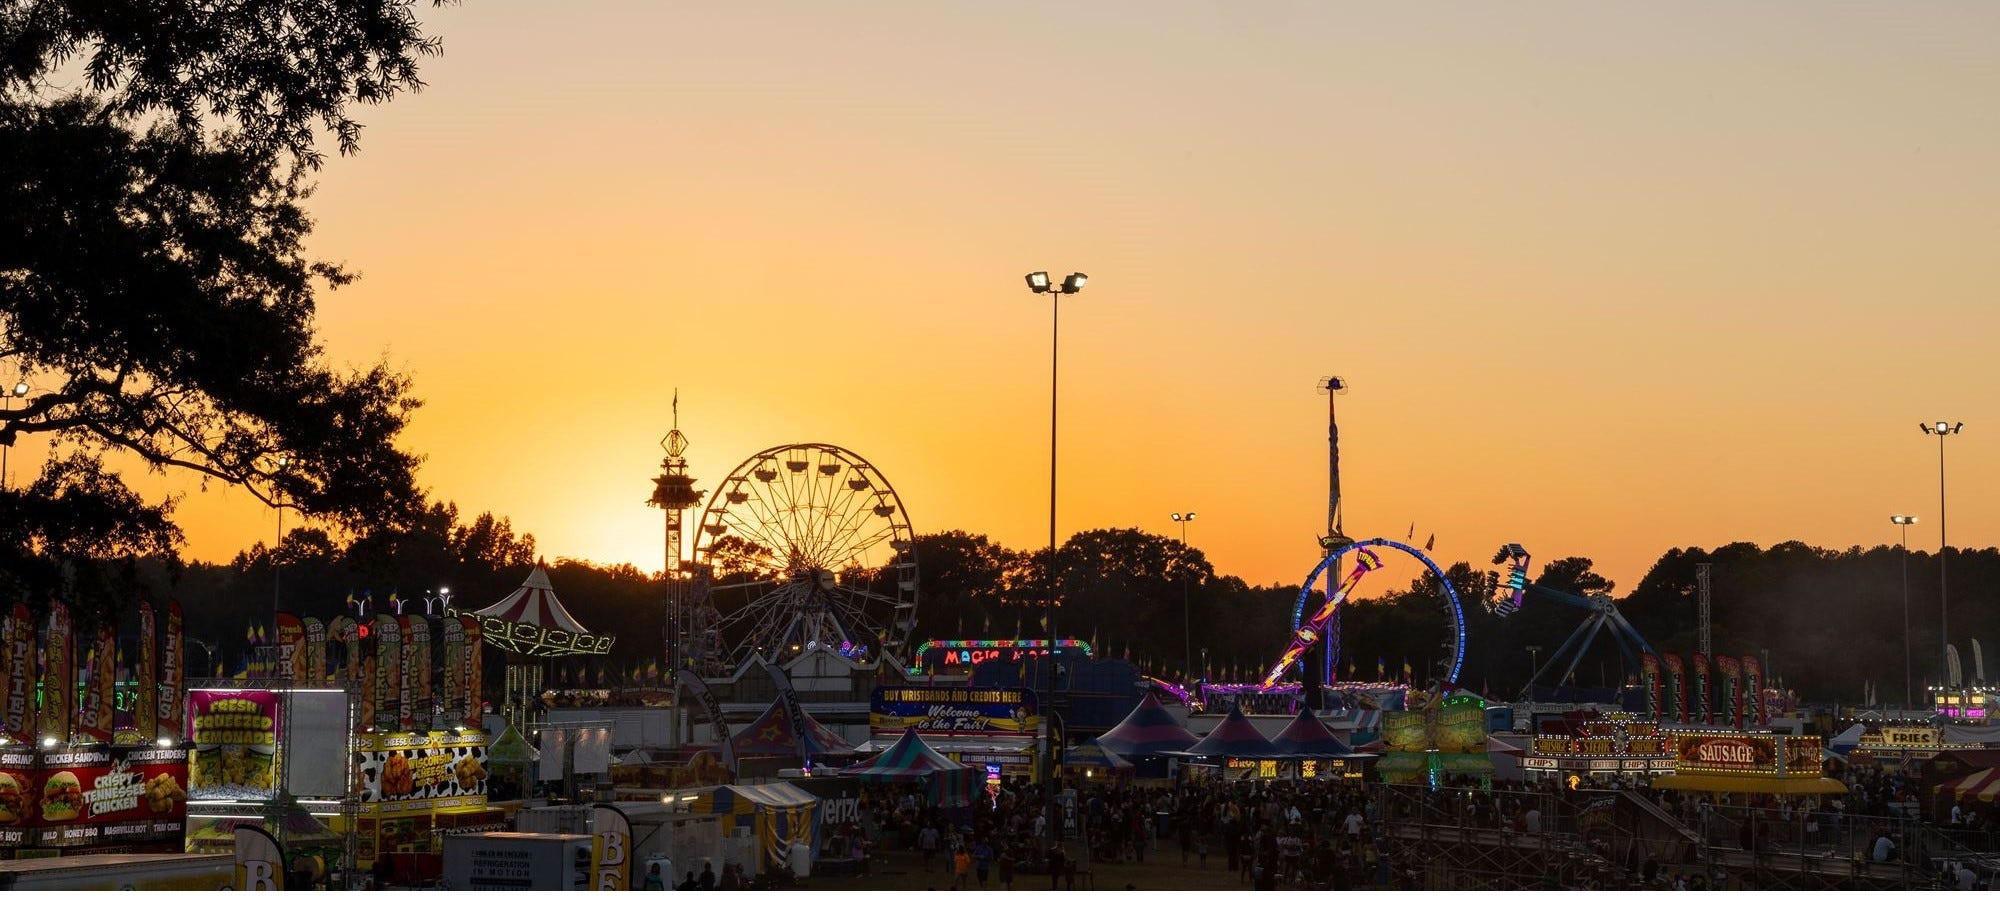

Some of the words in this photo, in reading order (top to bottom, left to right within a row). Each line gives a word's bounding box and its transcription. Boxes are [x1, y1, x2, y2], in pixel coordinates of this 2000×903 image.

[884, 690, 899, 701] BUY
[901, 690, 950, 702] WRISTBANDS
[952, 690, 968, 702] AND
[970, 691, 1000, 703] CREDITS
[1002, 691, 1022, 703] HERE
[209, 698, 258, 714] FRESH
[928, 705, 980, 718] Welcome
[194, 713, 274, 731] SQUEEZED
[918, 719, 931, 730] to
[932, 718, 951, 730] the
[953, 717, 990, 731] Fair!
[193, 730, 274, 746] LEMONADE
[1893, 733, 1930, 743] FRIES
[1, 753, 35, 765] SHRIMP
[43, 753, 73, 764] CHICKEN
[74, 751, 111, 763] SANDWICH
[127, 750, 155, 761] CHICKEN
[156, 748, 187, 761] TENDERS
[1699, 744, 1755, 763] SAUSAGE
[1787, 746, 1819, 763] SAUSAGE
[408, 752, 454, 770] WISCONSIN
[1528, 760, 1554, 768] CHIPS
[1624, 760, 1646, 769] CHIPS
[93, 772, 135, 789] CRISPY
[82, 781, 147, 804] TENNESSEE
[92, 796, 139, 815] CHICKEN
[5, 831, 24, 842] HOT
[42, 830, 58, 841] MILD
[64, 828, 84, 839] HONEY
[84, 827, 99, 838] BBQ
[473, 860, 530, 869] REFRIGERATION
[489, 868, 530, 877] MOTION
